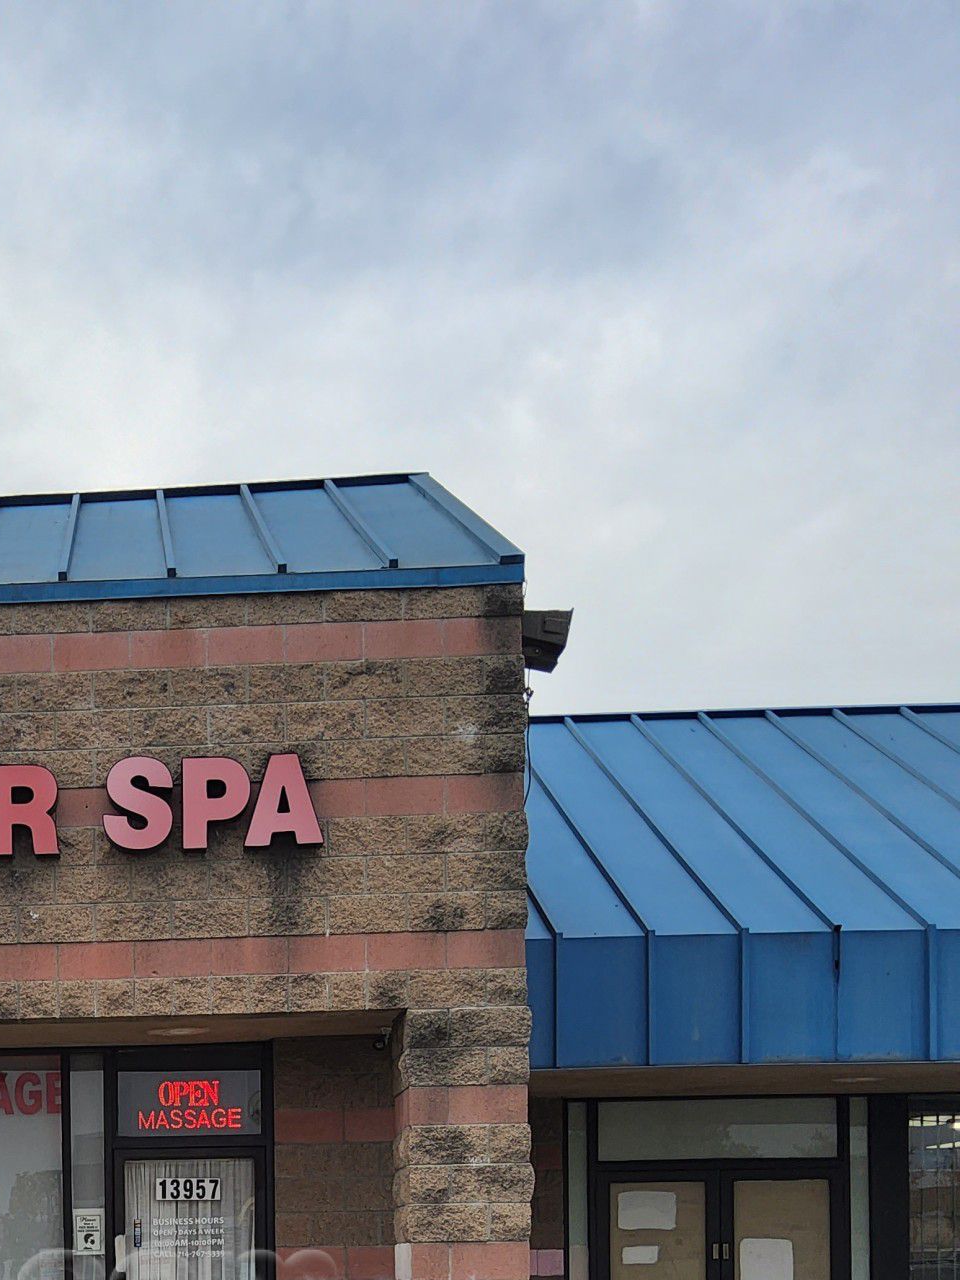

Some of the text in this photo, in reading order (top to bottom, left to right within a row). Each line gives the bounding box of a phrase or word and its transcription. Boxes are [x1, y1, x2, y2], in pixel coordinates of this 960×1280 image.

[102, 752, 325, 855] SPA
[158, 1081, 220, 1106] OPEN
[138, 1108, 242, 1129] MASSAGE
[159, 1179, 219, 1199] 13957
[152, 1216, 225, 1226] BUSINESS HOURS
